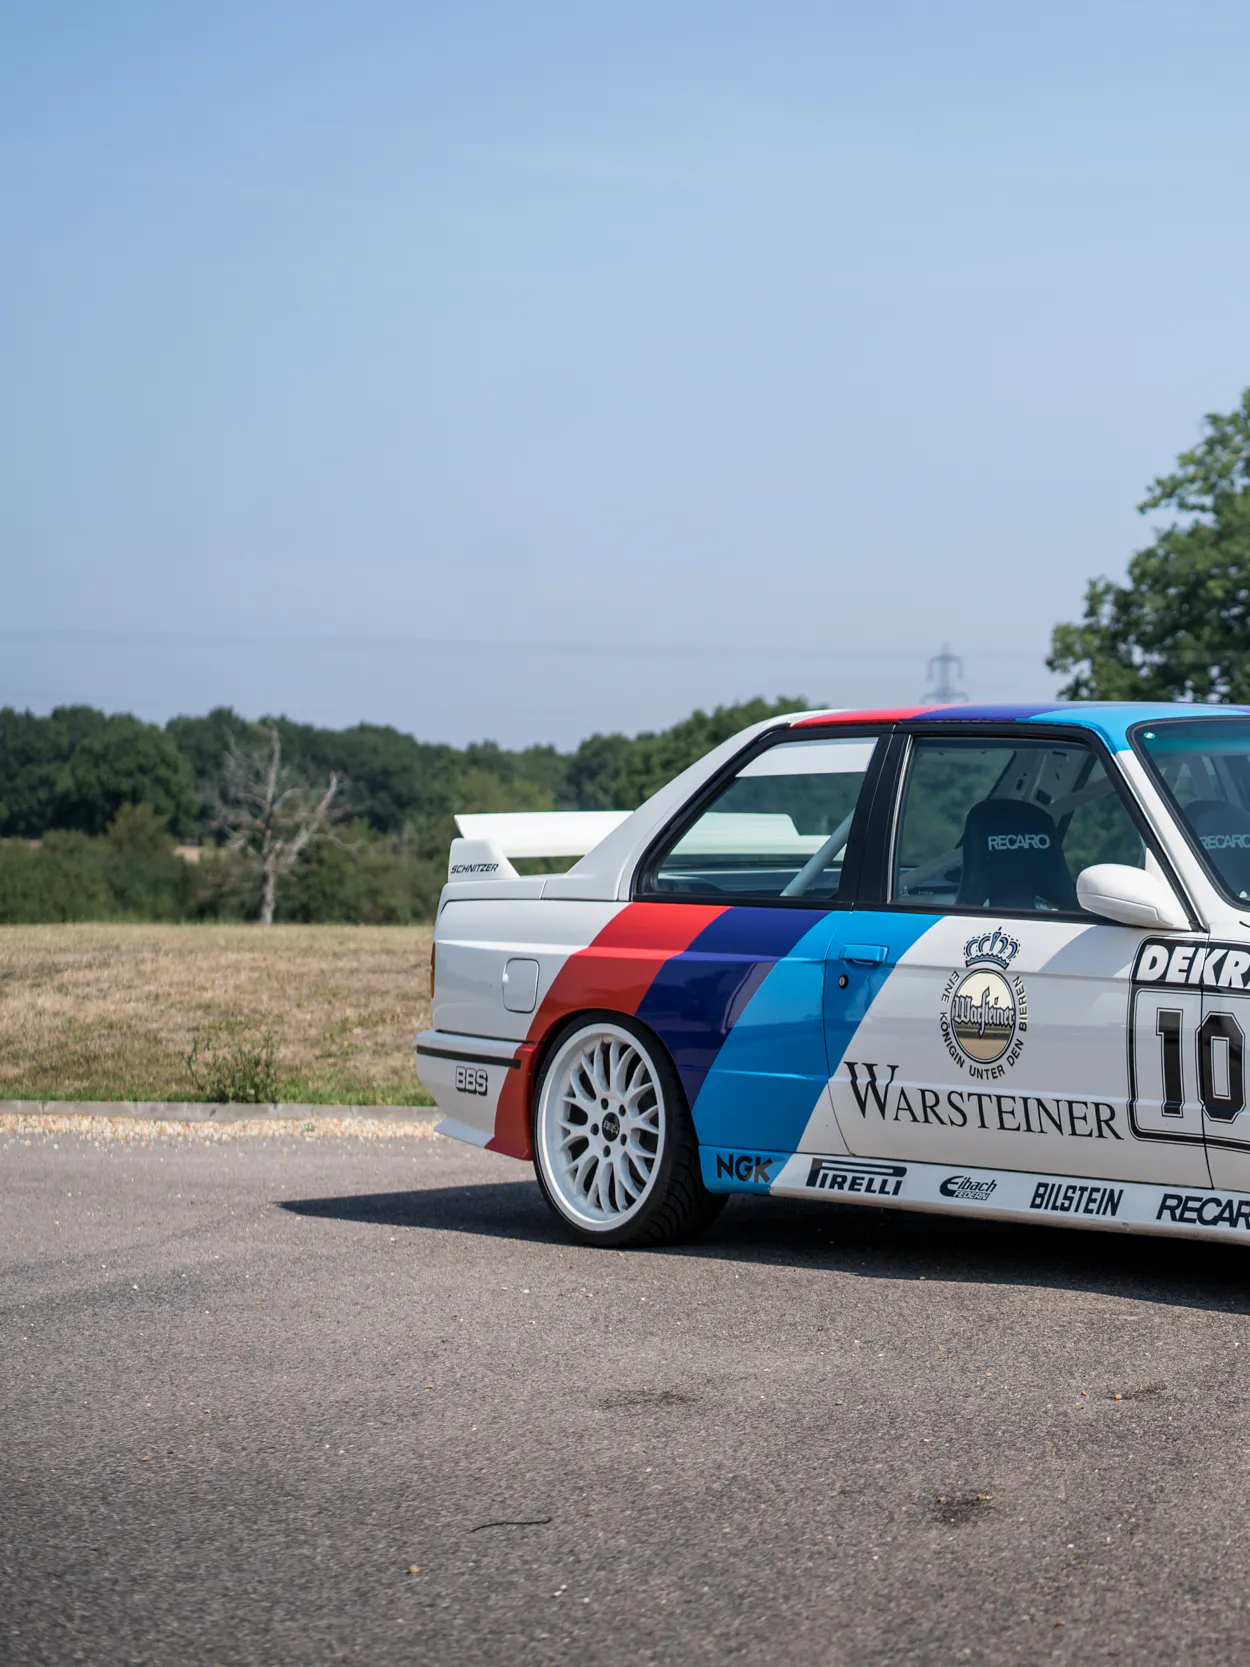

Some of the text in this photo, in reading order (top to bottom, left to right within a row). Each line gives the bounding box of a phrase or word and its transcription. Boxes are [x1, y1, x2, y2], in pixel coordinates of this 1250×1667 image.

[987, 833, 1050, 851] RECARO
[450, 863, 499, 874] SCHNITZER
[940, 970, 1027, 1081] EINE KÖNIGIN UNTER DEN BIEREN
[456, 1065, 488, 1097] BBS
[1155, 1007, 1247, 1125] 10
[843, 1061, 1125, 1141] WARSTEINER
[716, 1153, 773, 1184] NGK
[805, 1157, 908, 1196] PIRELLI
[939, 1175, 998, 1198] Eibach
[953, 1190, 990, 1201] FEDERN
[1029, 1182, 1124, 1216] BILSTEIN
